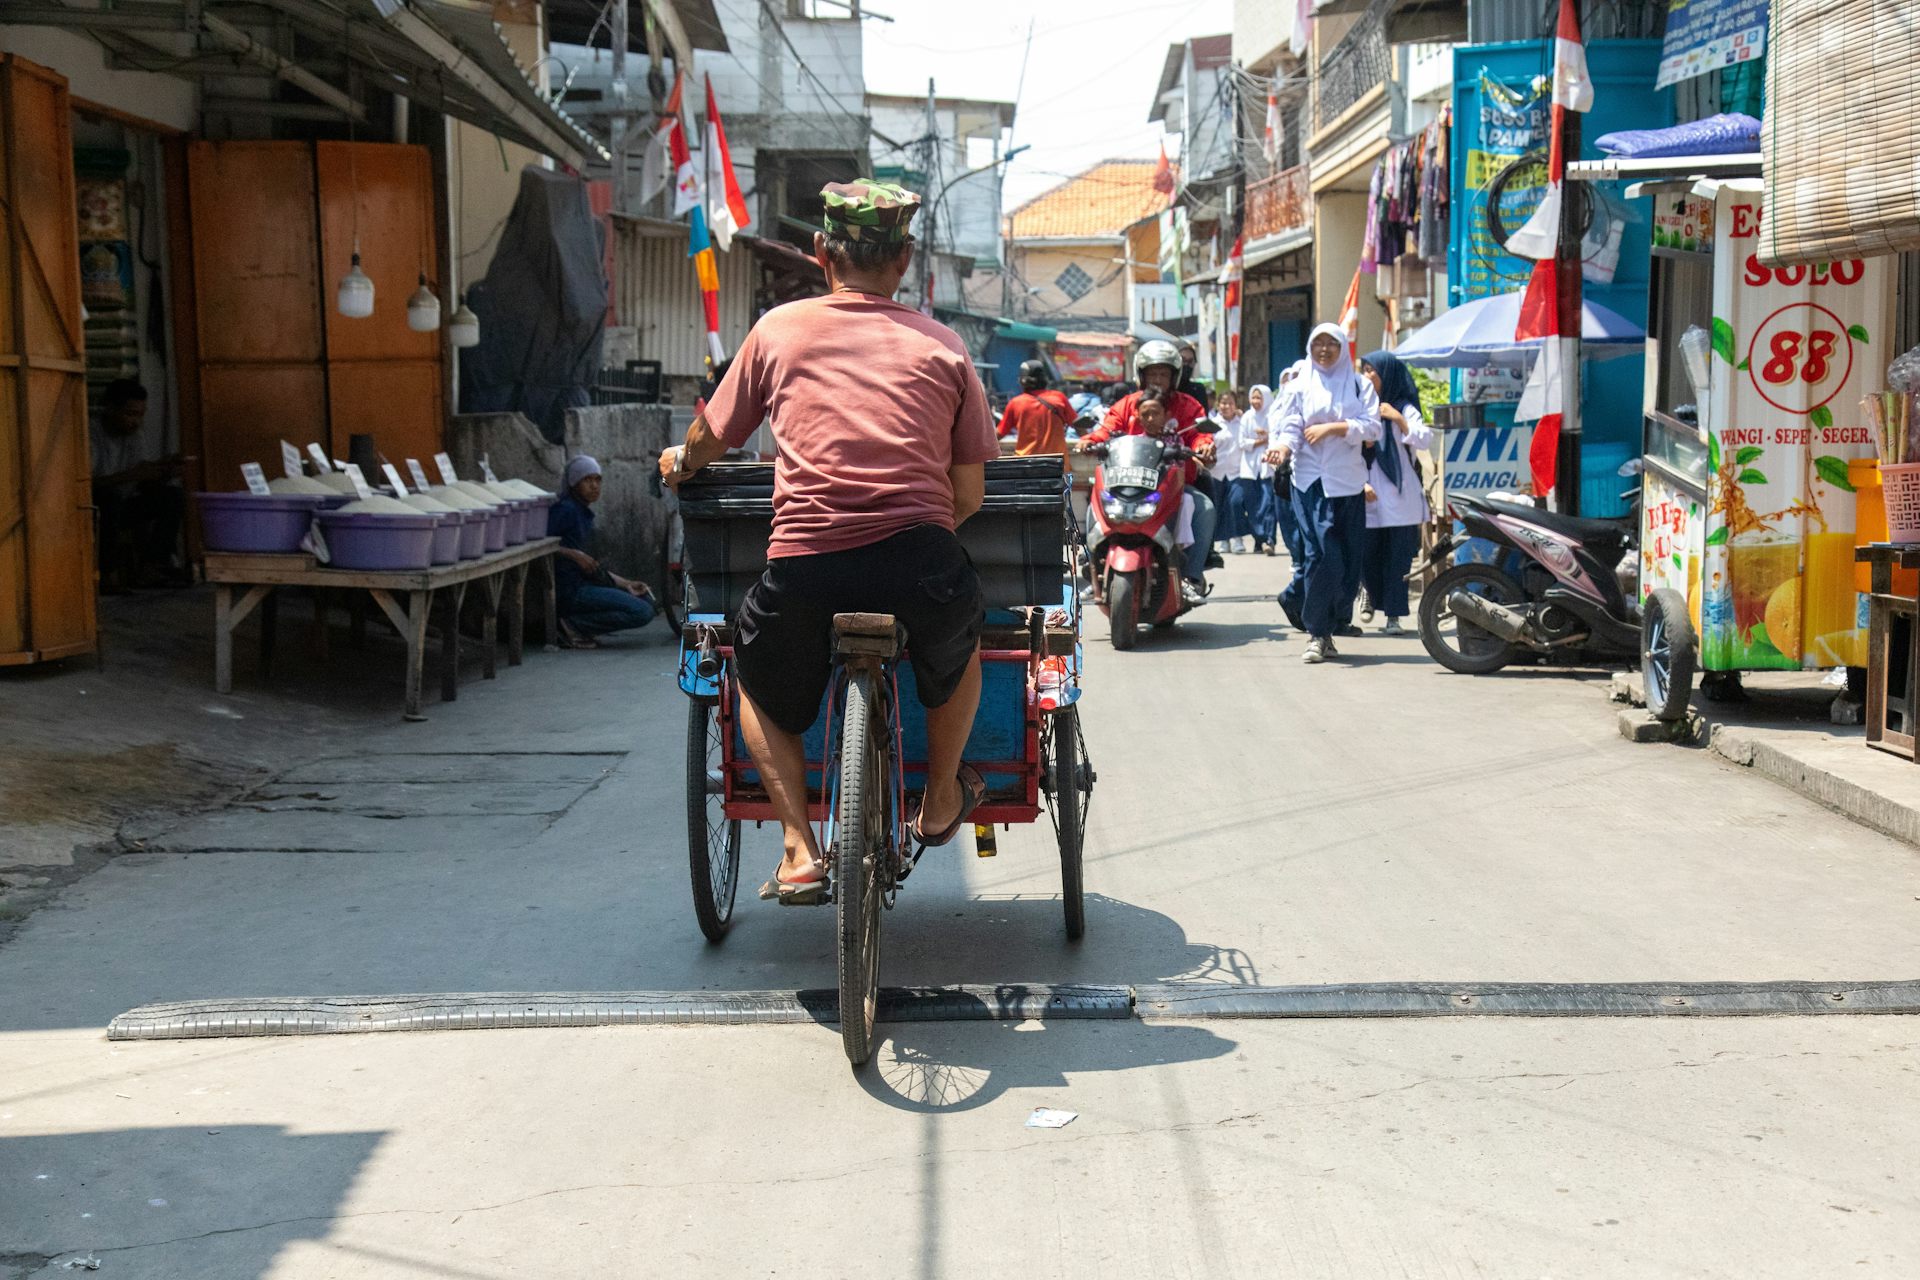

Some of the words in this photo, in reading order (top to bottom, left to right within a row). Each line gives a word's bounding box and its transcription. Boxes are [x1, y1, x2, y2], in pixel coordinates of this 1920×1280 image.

[1729, 203, 1765, 239] E
[1744, 253, 1865, 287] SOLO
[1762, 330, 1839, 385] 88
[1720, 428, 1763, 446] WANGI
